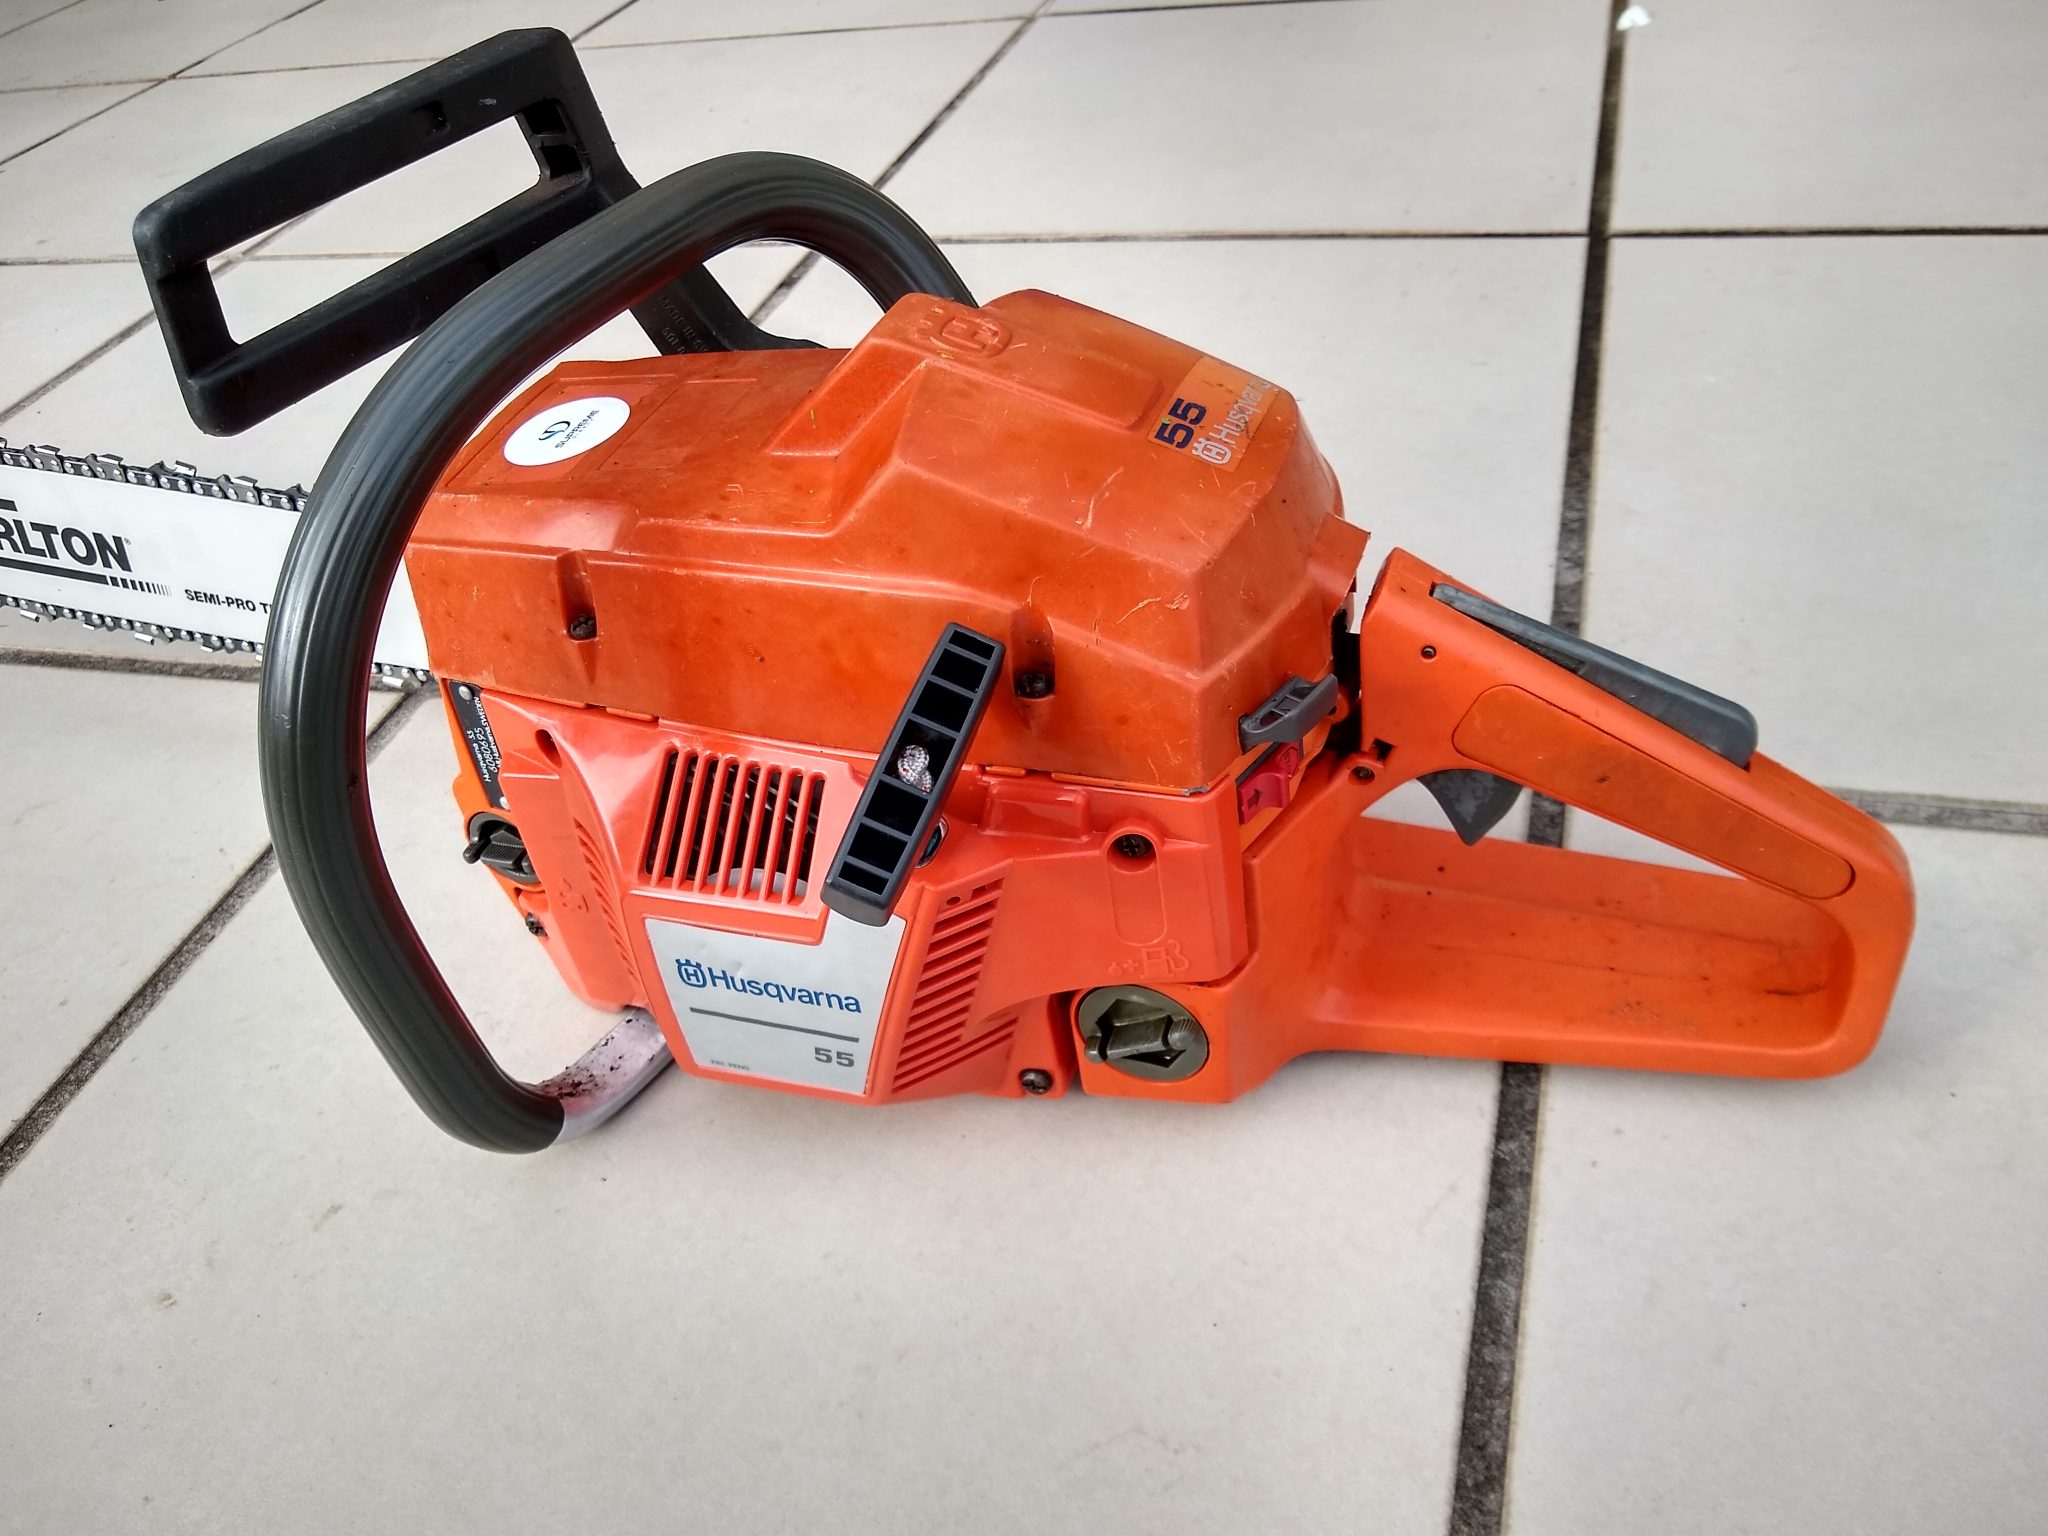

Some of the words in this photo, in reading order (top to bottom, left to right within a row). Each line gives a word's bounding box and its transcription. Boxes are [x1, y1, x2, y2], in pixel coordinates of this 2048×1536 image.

[1154, 397, 1207, 449] 55
[184, 589, 256, 612] SEMI-PRO
[259, 602, 273, 614] T
[707, 966, 862, 1013] Husqvarna
[814, 1046, 855, 1068] 55
